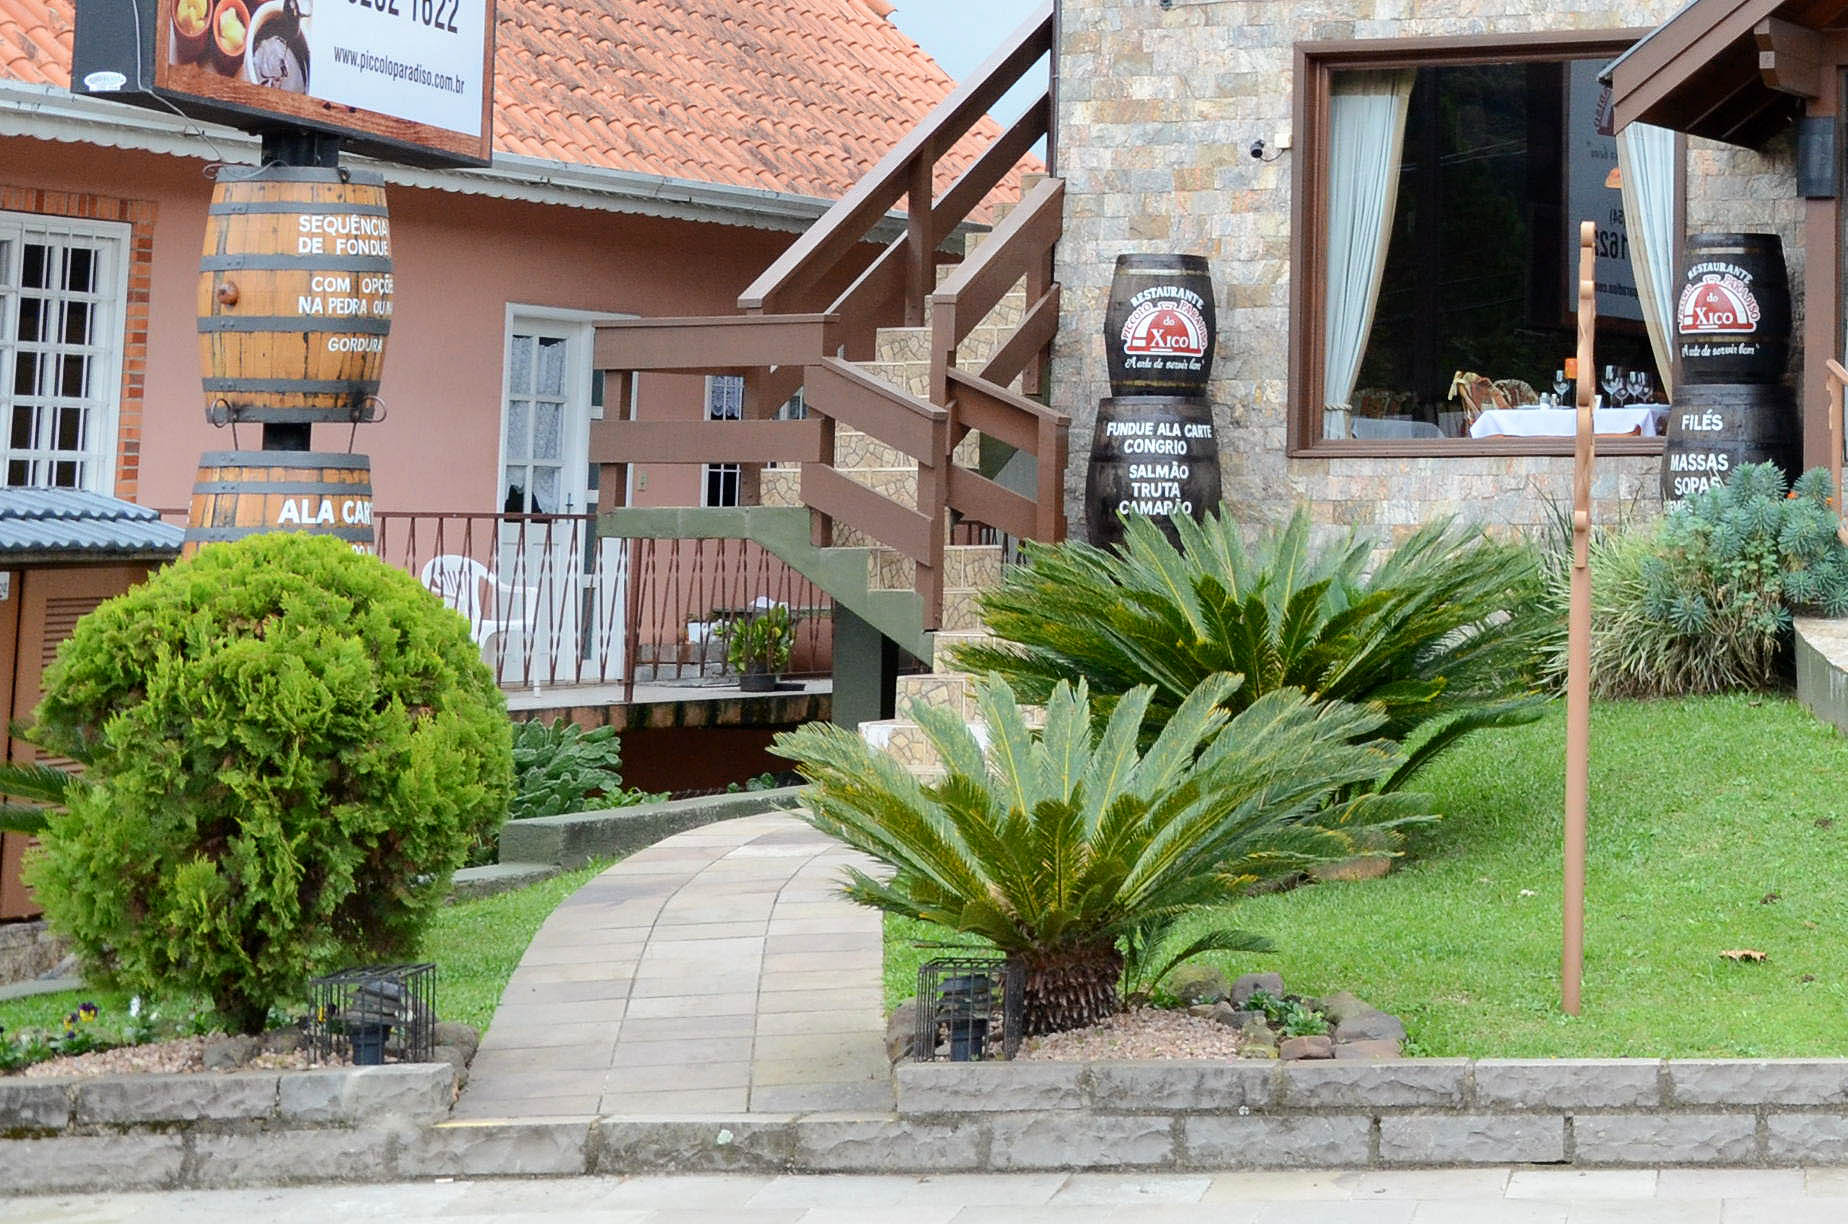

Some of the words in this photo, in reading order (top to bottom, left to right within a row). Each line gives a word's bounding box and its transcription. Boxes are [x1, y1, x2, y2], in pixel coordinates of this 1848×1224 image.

[333, 46, 465, 94] www.piccoloparadiso.com.br
[299, 214, 388, 236] SEQUÊNCIA
[298, 237, 323, 254] DE
[335, 239, 389, 256] FONDUE
[1687, 262, 1753, 284] RESTAURANTE
[311, 276, 351, 293] COM
[298, 296, 323, 314] NA
[328, 297, 367, 314] PEDRA
[1130, 286, 1205, 310] RESTAURANTE
[1707, 292, 1719, 303] do
[1163, 315, 1175, 326] do
[328, 337, 383, 352] GORDURA
[1681, 409, 1723, 431] FILÉS
[1107, 422, 1154, 436] FUNDUE
[1157, 423, 1181, 436] ALA
[1184, 424, 1212, 438] CARTE
[1124, 439, 1187, 455] CONGRIO
[1129, 461, 1189, 479] SALMÃO
[1670, 453, 1729, 472] MASSAS
[1131, 482, 1181, 497] TRUTA
[277, 499, 335, 524] ALA
